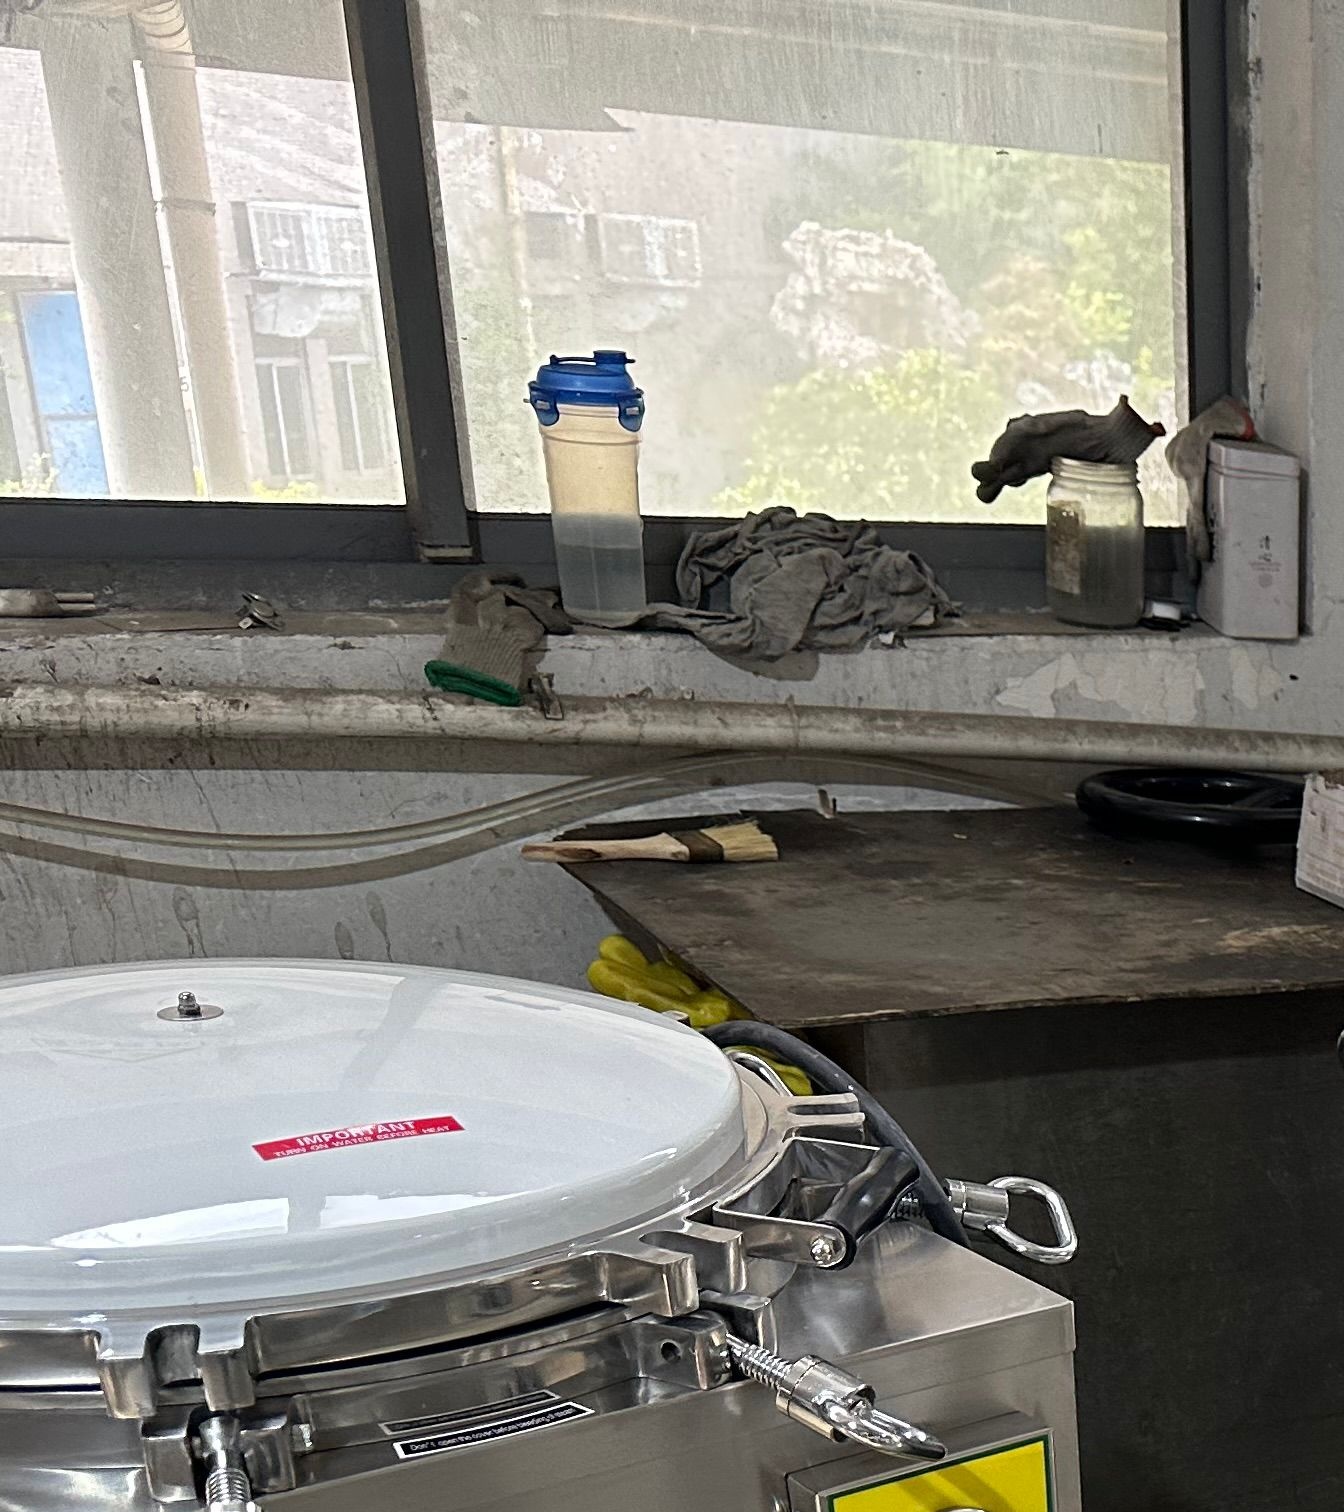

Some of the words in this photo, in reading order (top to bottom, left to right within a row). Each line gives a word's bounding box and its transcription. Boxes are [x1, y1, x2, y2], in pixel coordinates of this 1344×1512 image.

[273, 1147, 307, 1158] TURN
[310, 1142, 328, 1152] ON
[333, 1136, 374, 1148] WATER
[377, 1129, 417, 1141] BEFORE
[422, 1125, 449, 1134] HEAT
[296, 1121, 415, 1147] IMPORTANT
